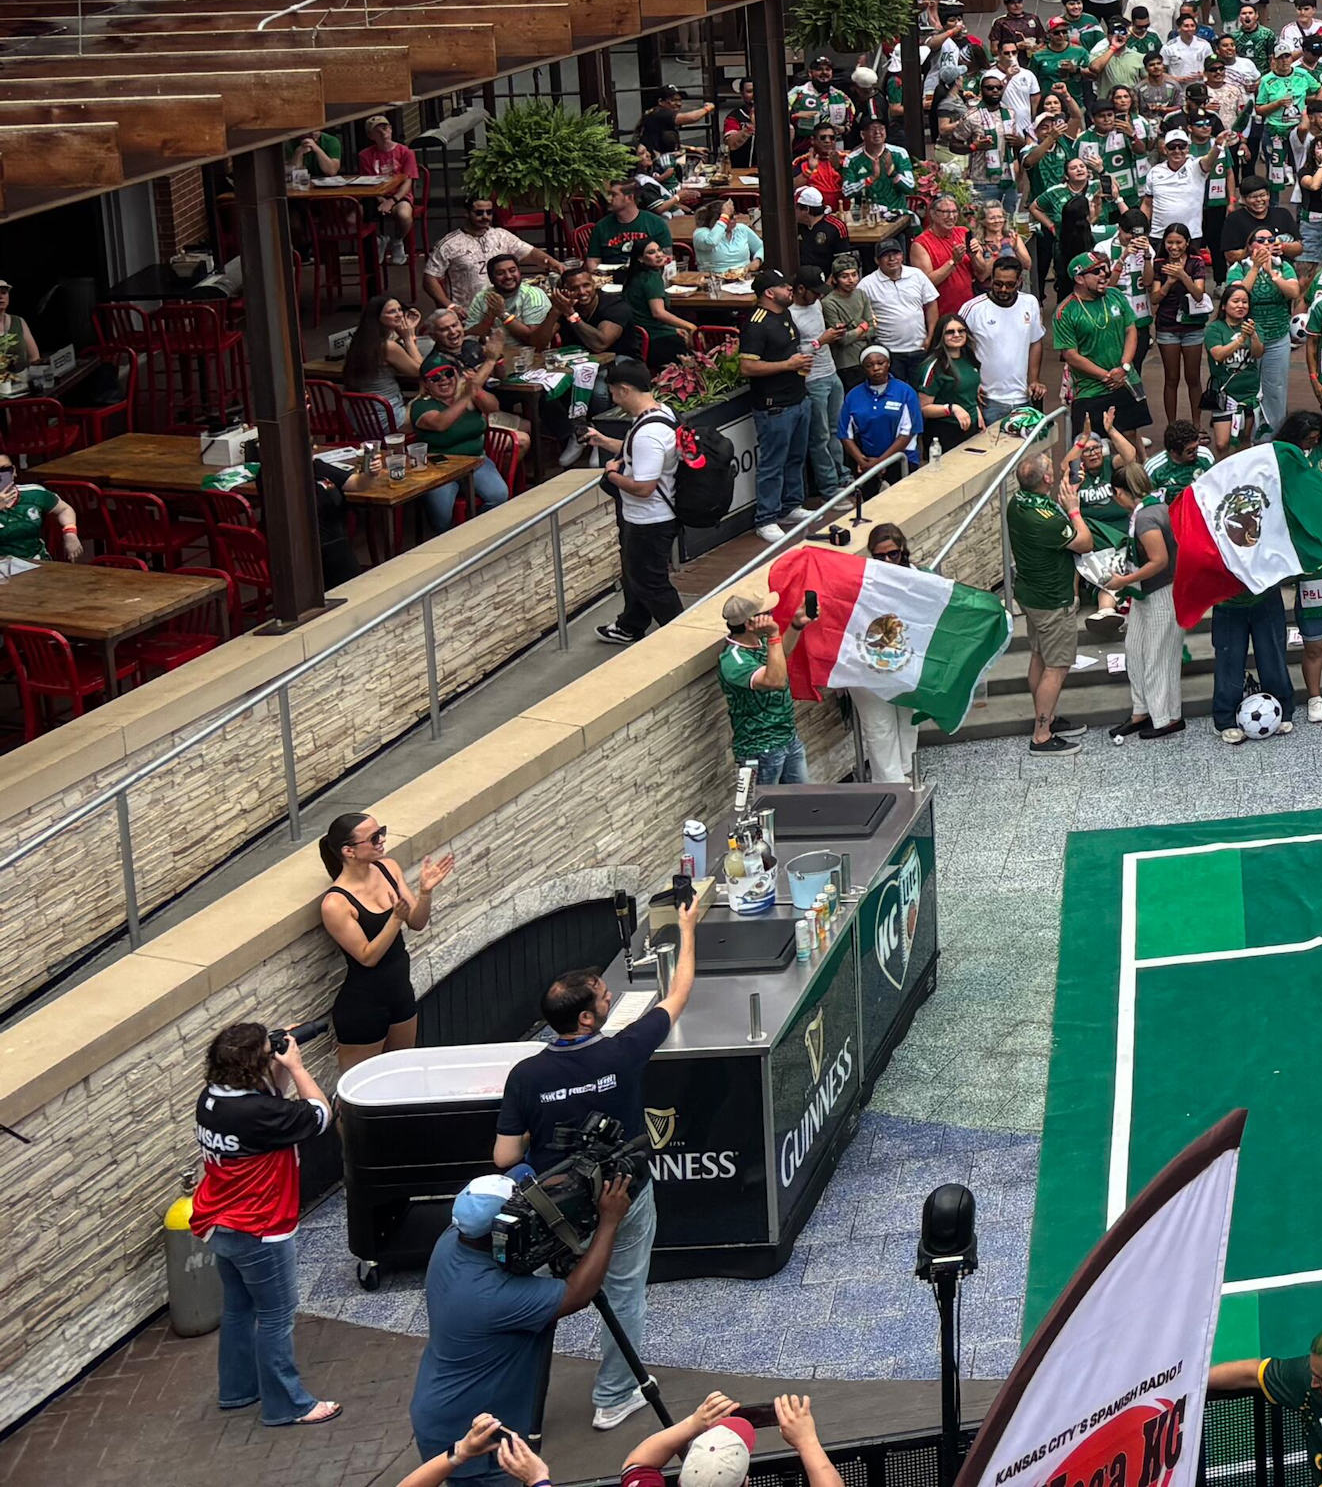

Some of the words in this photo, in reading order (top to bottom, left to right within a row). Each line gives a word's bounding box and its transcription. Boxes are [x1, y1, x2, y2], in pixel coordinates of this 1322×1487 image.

[1111, 154, 1125, 168] C
[780, 1034, 854, 1189] GUINNESS
[995, 1443, 1047, 1486] KANSAS
[1048, 1416, 1088, 1454] CITY'S
[1089, 1387, 1139, 1429] SPANISH
